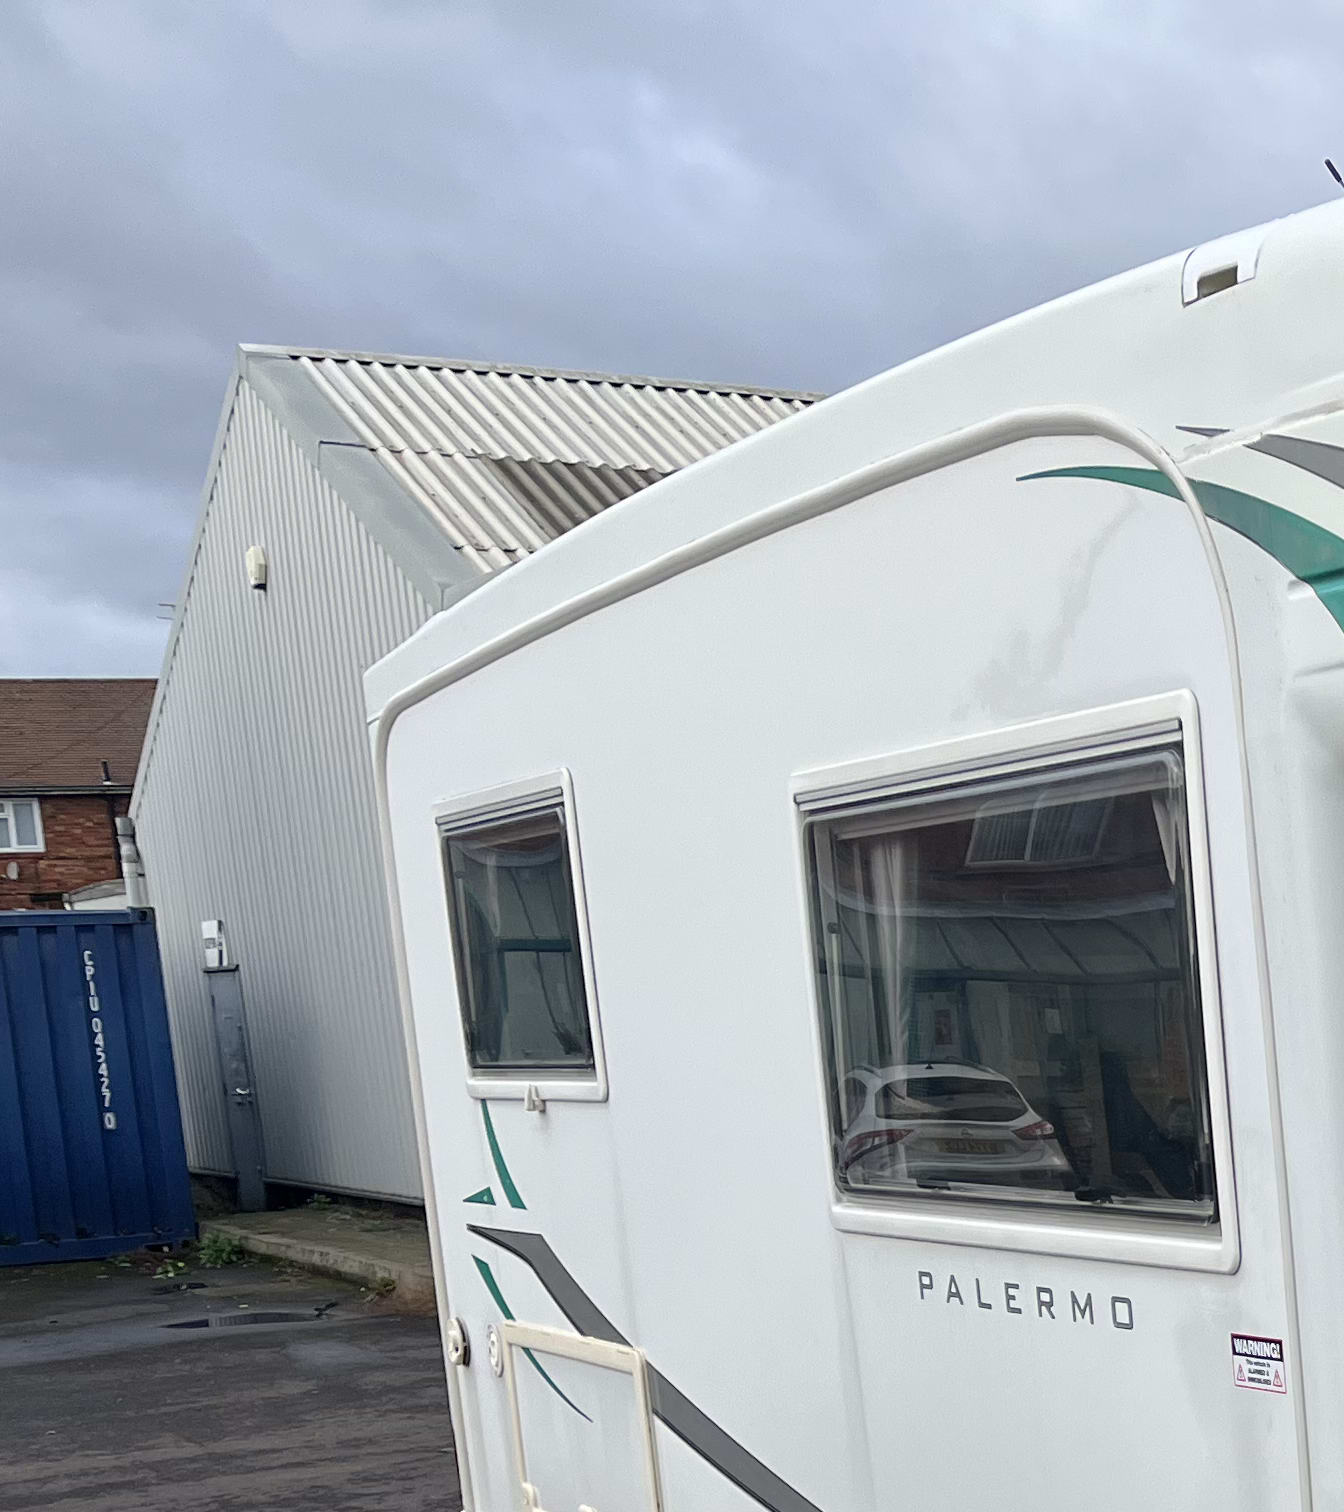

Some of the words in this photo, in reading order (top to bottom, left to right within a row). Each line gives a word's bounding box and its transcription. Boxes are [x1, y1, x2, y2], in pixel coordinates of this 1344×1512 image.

[83, 950, 101, 1013] CPIU
[91, 1017, 111, 1108] 045427
[917, 1270, 1136, 1331] PALERMO
[1233, 1337, 1281, 1359] WARNING!
